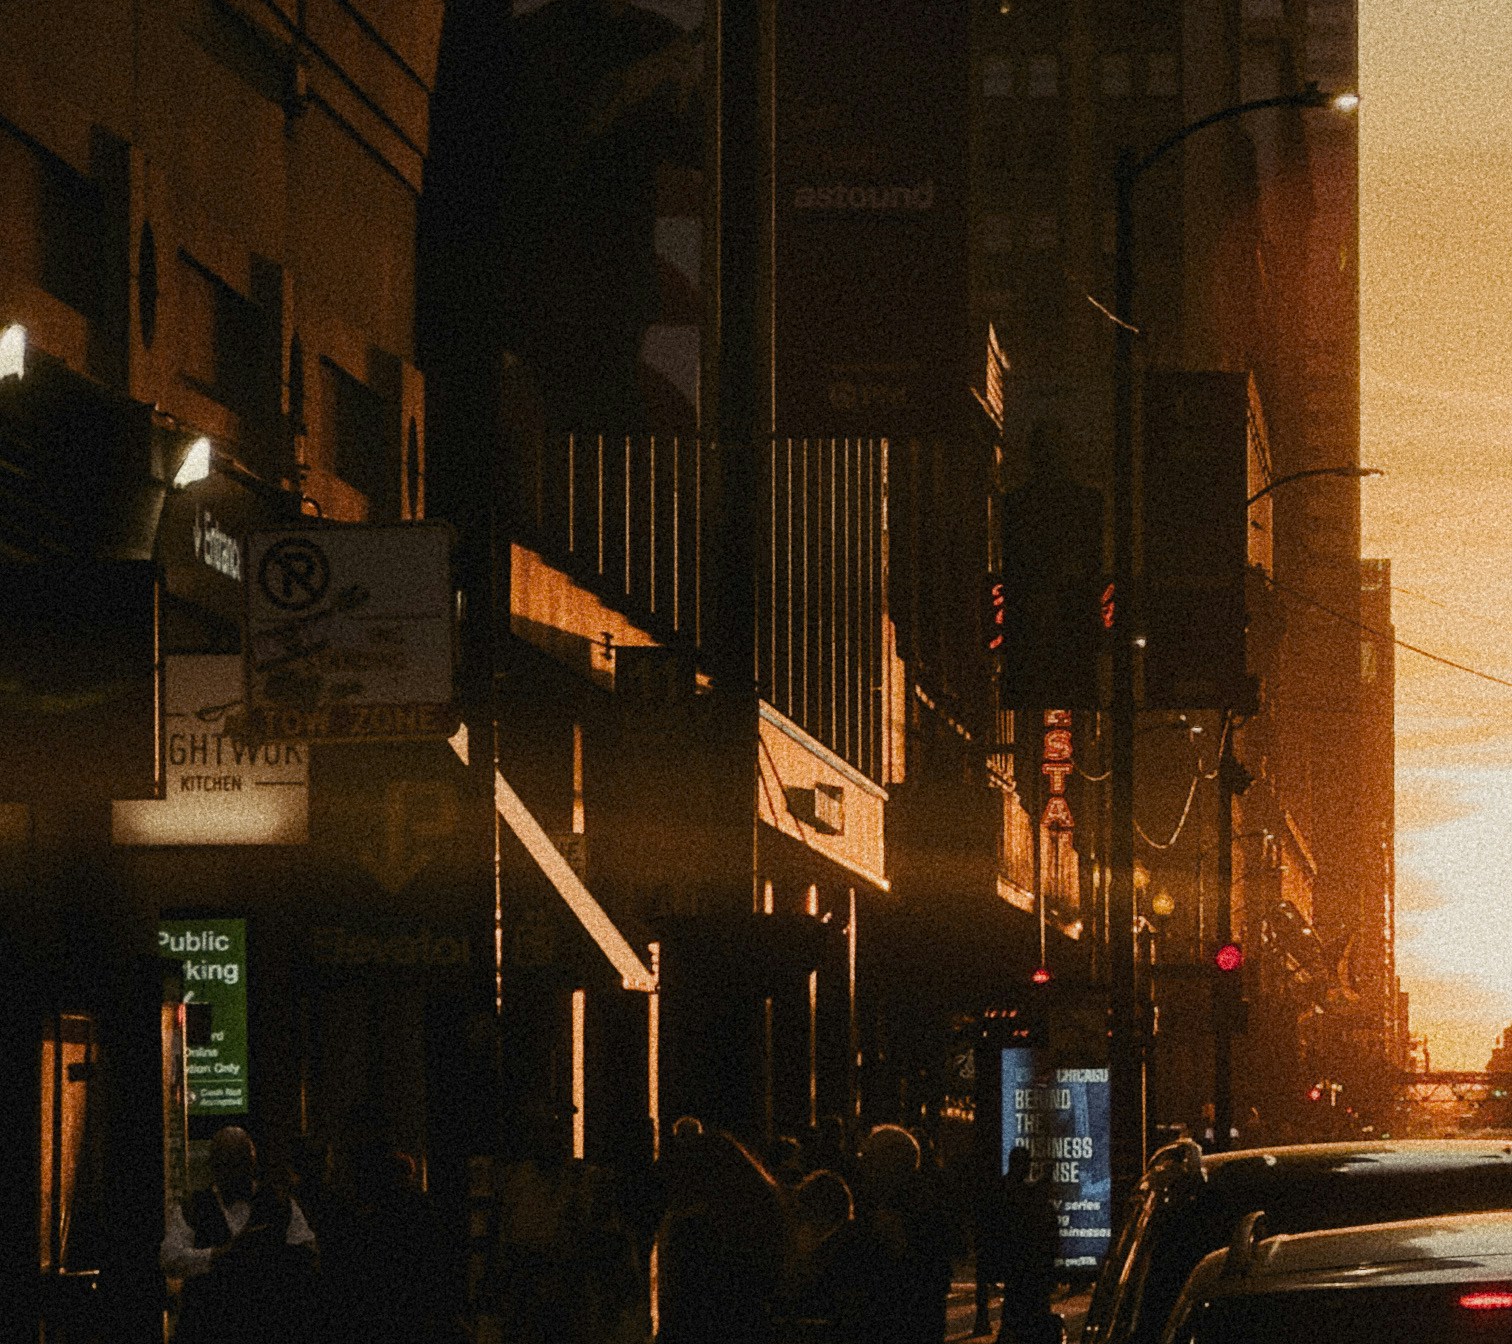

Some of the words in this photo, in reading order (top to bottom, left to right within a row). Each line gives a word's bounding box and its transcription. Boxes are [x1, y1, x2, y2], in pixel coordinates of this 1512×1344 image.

[794, 177, 935, 210] astound
[263, 708, 330, 737] TOW
[350, 705, 438, 734] ZONE
[180, 775, 243, 792] KITCHEN
[158, 930, 231, 953] Public
[183, 959, 241, 985] king
